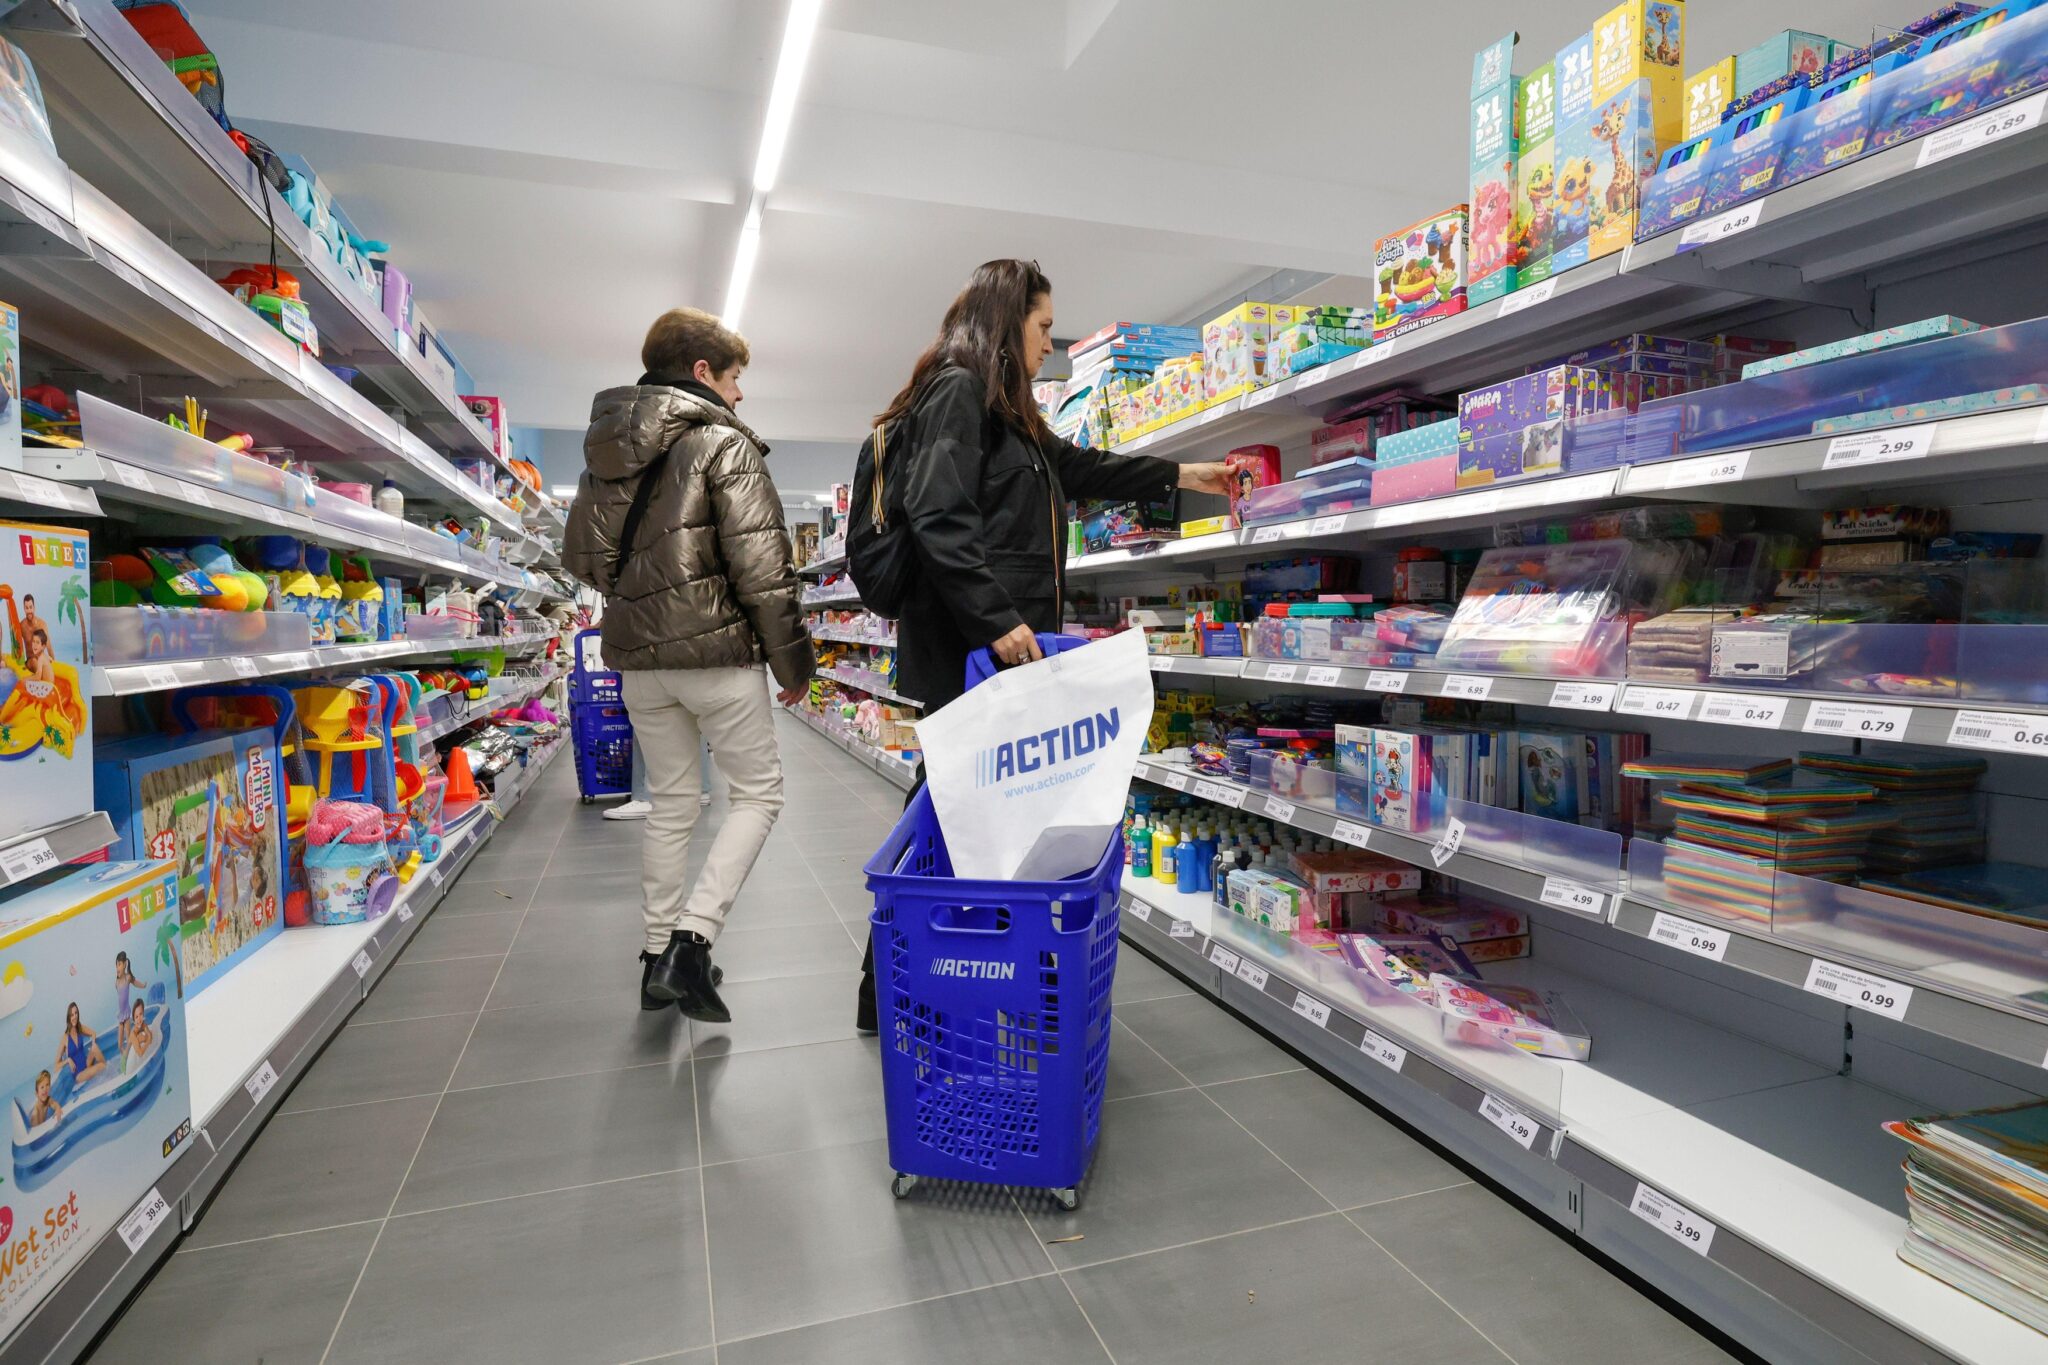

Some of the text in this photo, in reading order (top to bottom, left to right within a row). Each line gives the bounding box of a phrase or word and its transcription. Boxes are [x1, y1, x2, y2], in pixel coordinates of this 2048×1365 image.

[1600, 12, 1631, 52] XL
[1563, 44, 1592, 81] XL
[1526, 72, 1553, 108] XL
[1690, 74, 1722, 109] XL
[1476, 95, 1502, 128] XL
[1985, 114, 2026, 136] 0.89
[1723, 215, 1750, 232] 0.49
[1382, 238, 1400, 252] fun
[1376, 244, 1404, 266] dough
[1385, 330, 1396, 340] ICE
[1396, 320, 1420, 335] CREAM
[1879, 440, 1914, 455] 2.99
[1711, 465, 1736, 477] 0.95
[1832, 519, 1888, 530] Craft Sticks
[25, 542, 86, 563] INTEX
[1467, 686, 1484, 695] 6.95
[1582, 695, 1603, 704] 1.99
[1656, 701, 1680, 711] 0.47
[1745, 709, 1774, 721] 0.47
[1861, 720, 1894, 733] 0.79
[996, 706, 1120, 782] ACTION
[252, 752, 264, 823] MATTERS
[262, 766, 271, 802] MINI
[1350, 832, 1363, 841] 0.79
[32, 849, 55, 865] 39.95
[121, 882, 175, 925] INTEX
[1572, 894, 1593, 905] 4.99
[1691, 937, 1717, 952] 0.99
[941, 959, 1015, 980] ACTION
[1861, 990, 1894, 1008] 0.99
[1310, 1008, 1323, 1020] 9.95
[1382, 1049, 1397, 1062] 2.99
[1510, 1120, 1529, 1138] 1.99
[44, 1190, 78, 1240] Set
[145, 1198, 165, 1221] 39.95
[1674, 1220, 1701, 1242] 3.99
[0, 1220, 78, 1302] COLLECTION
